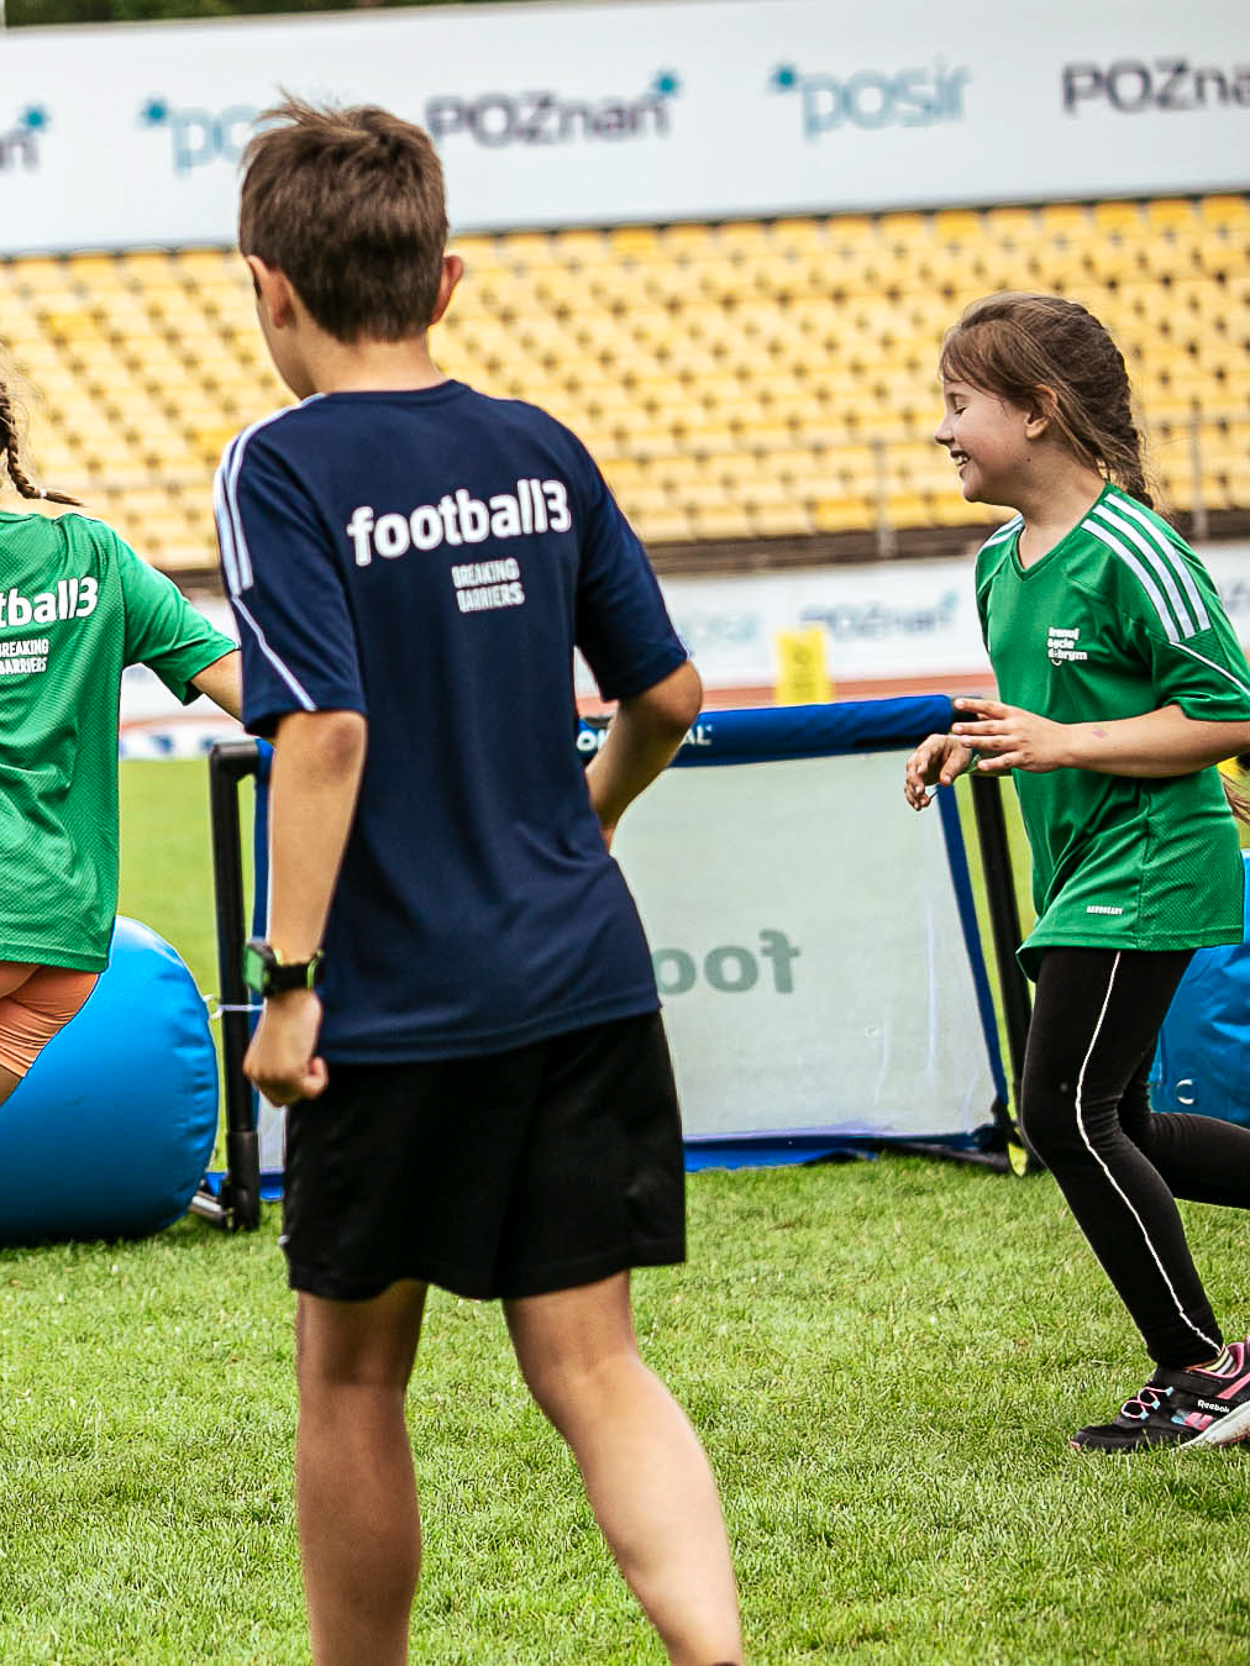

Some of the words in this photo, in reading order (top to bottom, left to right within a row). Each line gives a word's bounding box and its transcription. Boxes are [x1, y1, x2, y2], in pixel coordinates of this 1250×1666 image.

[347, 478, 571, 567] football3
[451, 557, 520, 588] BREAKING
[456, 581, 525, 613] BARRIERS
